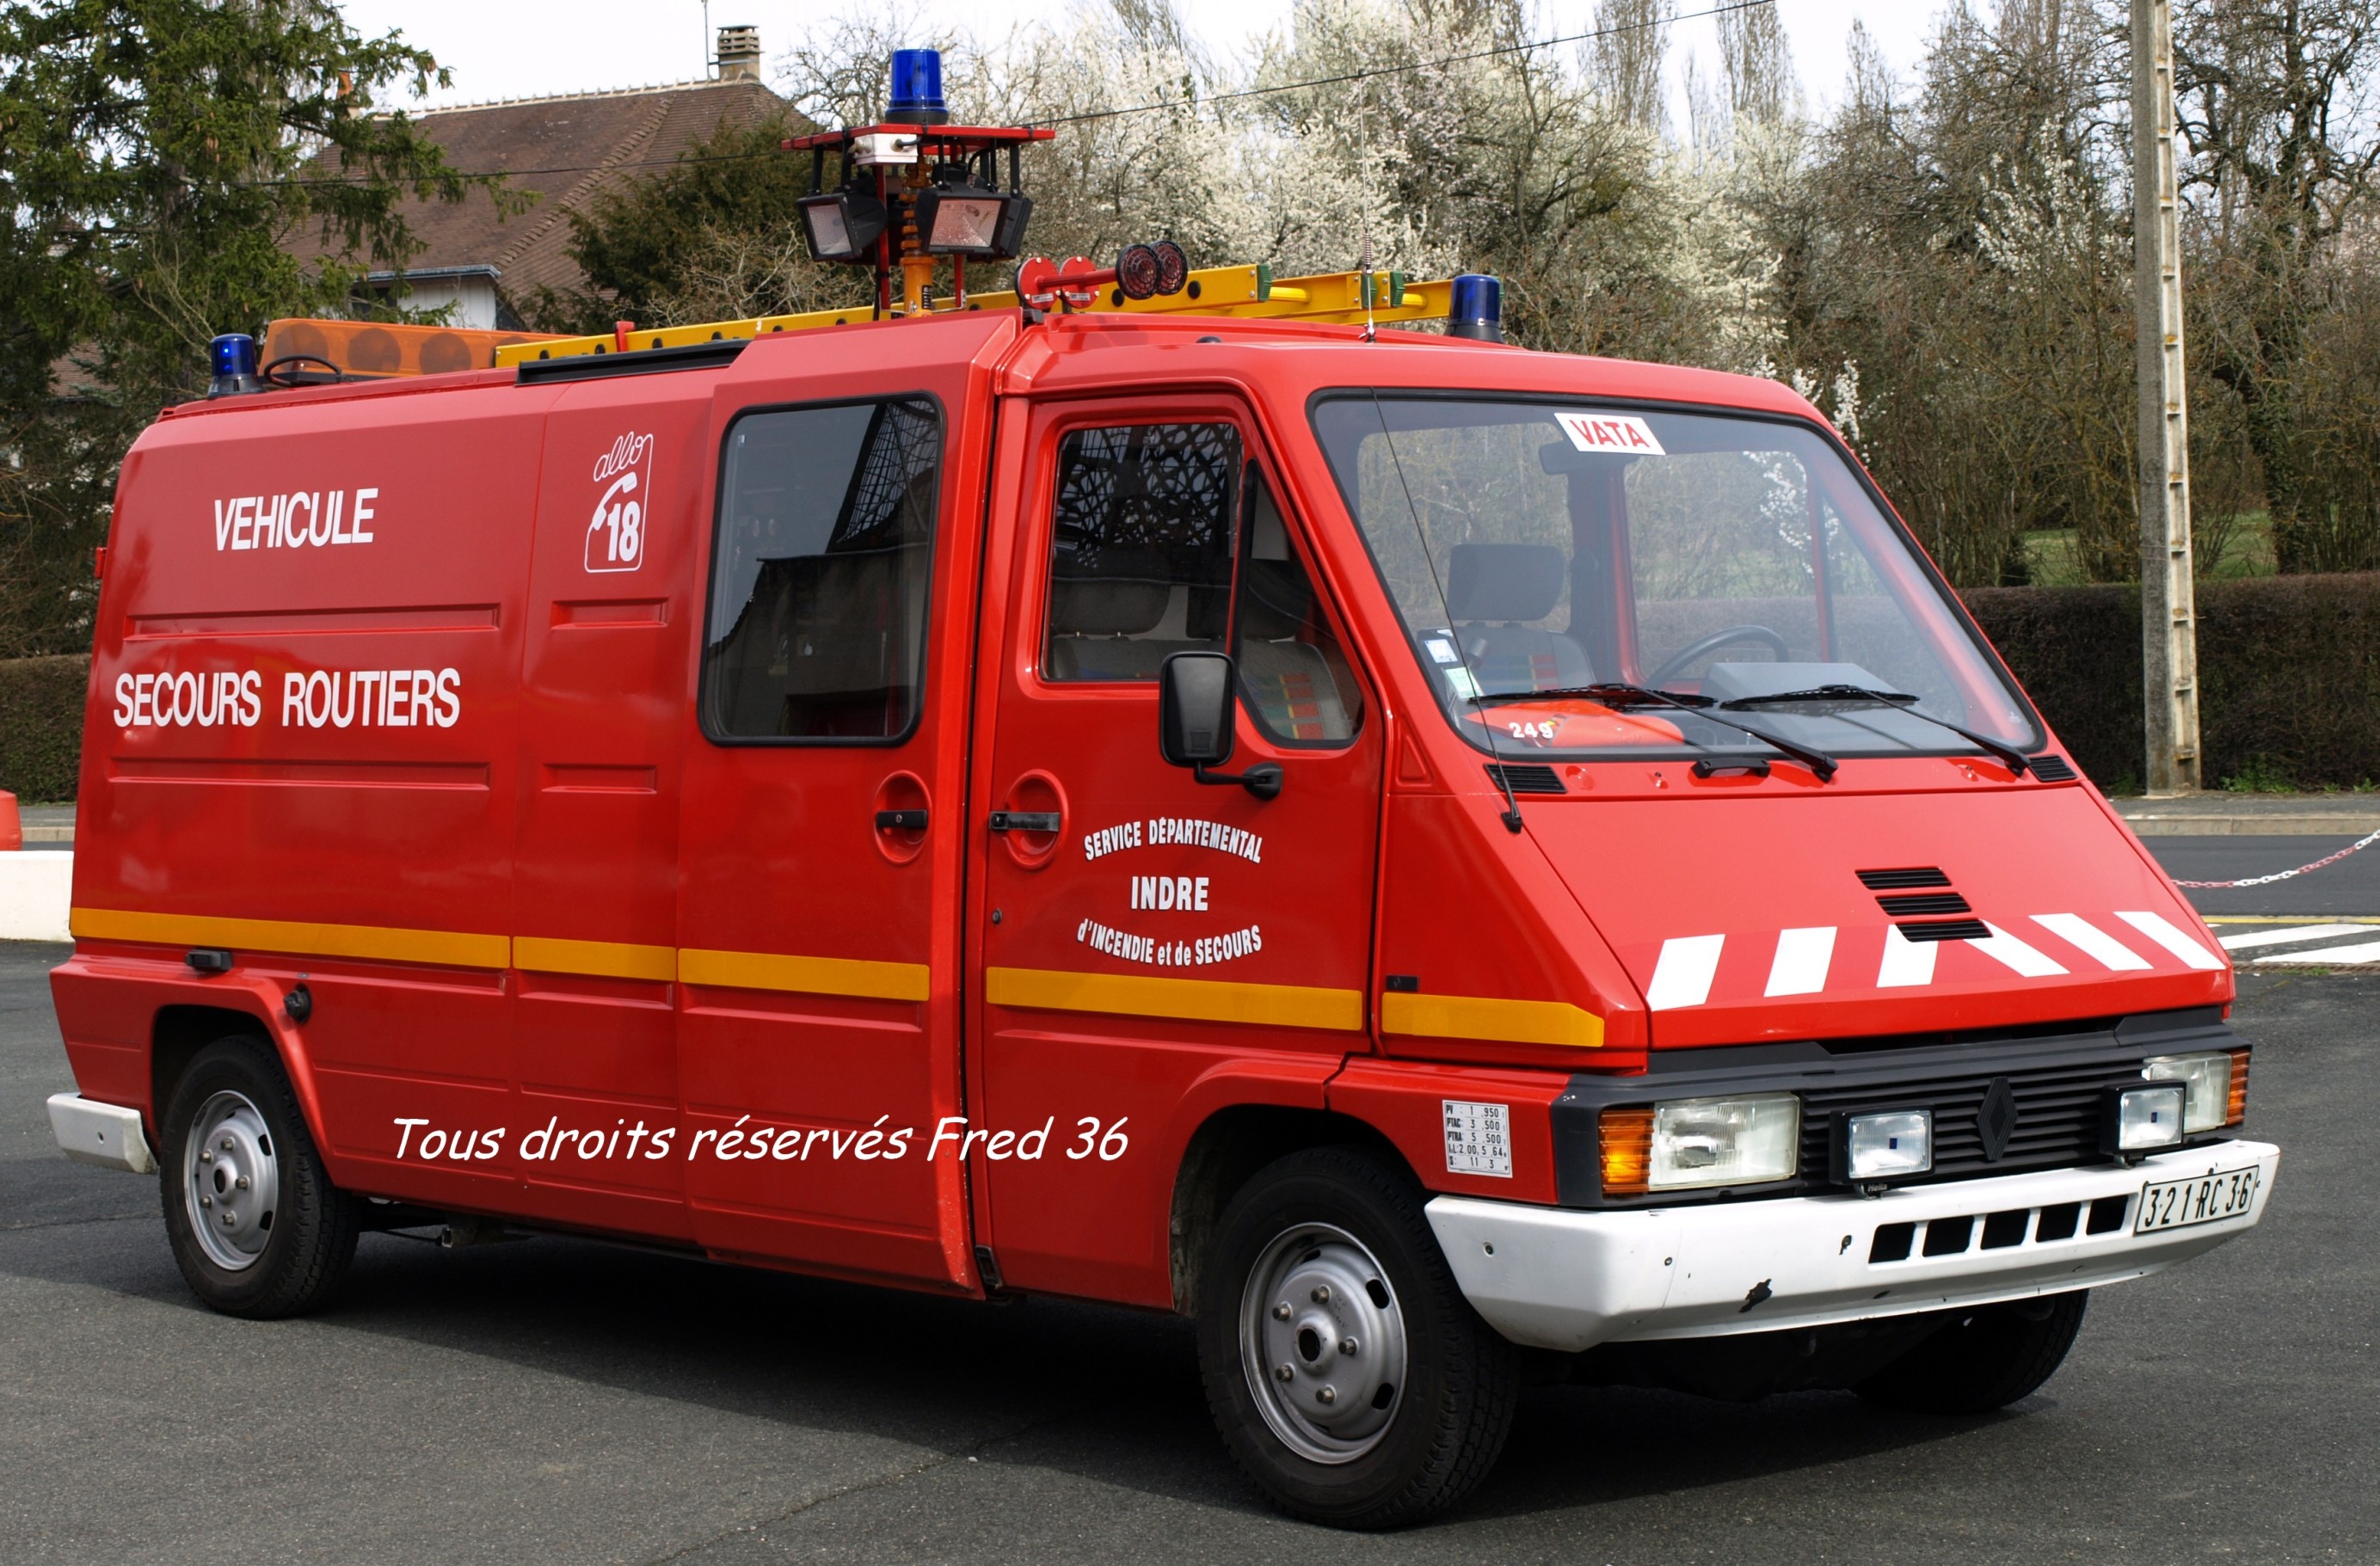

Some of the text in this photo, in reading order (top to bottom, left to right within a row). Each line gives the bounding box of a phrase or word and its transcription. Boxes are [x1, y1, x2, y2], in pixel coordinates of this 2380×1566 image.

[593, 431, 643, 482] allo
[1568, 419, 1651, 448] VATA
[214, 488, 378, 551] VEHICULE
[607, 501, 641, 562] 18
[114, 668, 461, 728] SECOURS ROUTIERS
[1084, 817, 1263, 863] SERVICE DÉPARTEMENTAL
[1131, 875, 1209, 911] INDRE
[1077, 918, 1262, 967] d'INCENDIE et de SECOURS
[2144, 1171, 2252, 1228] 321 RC 36
